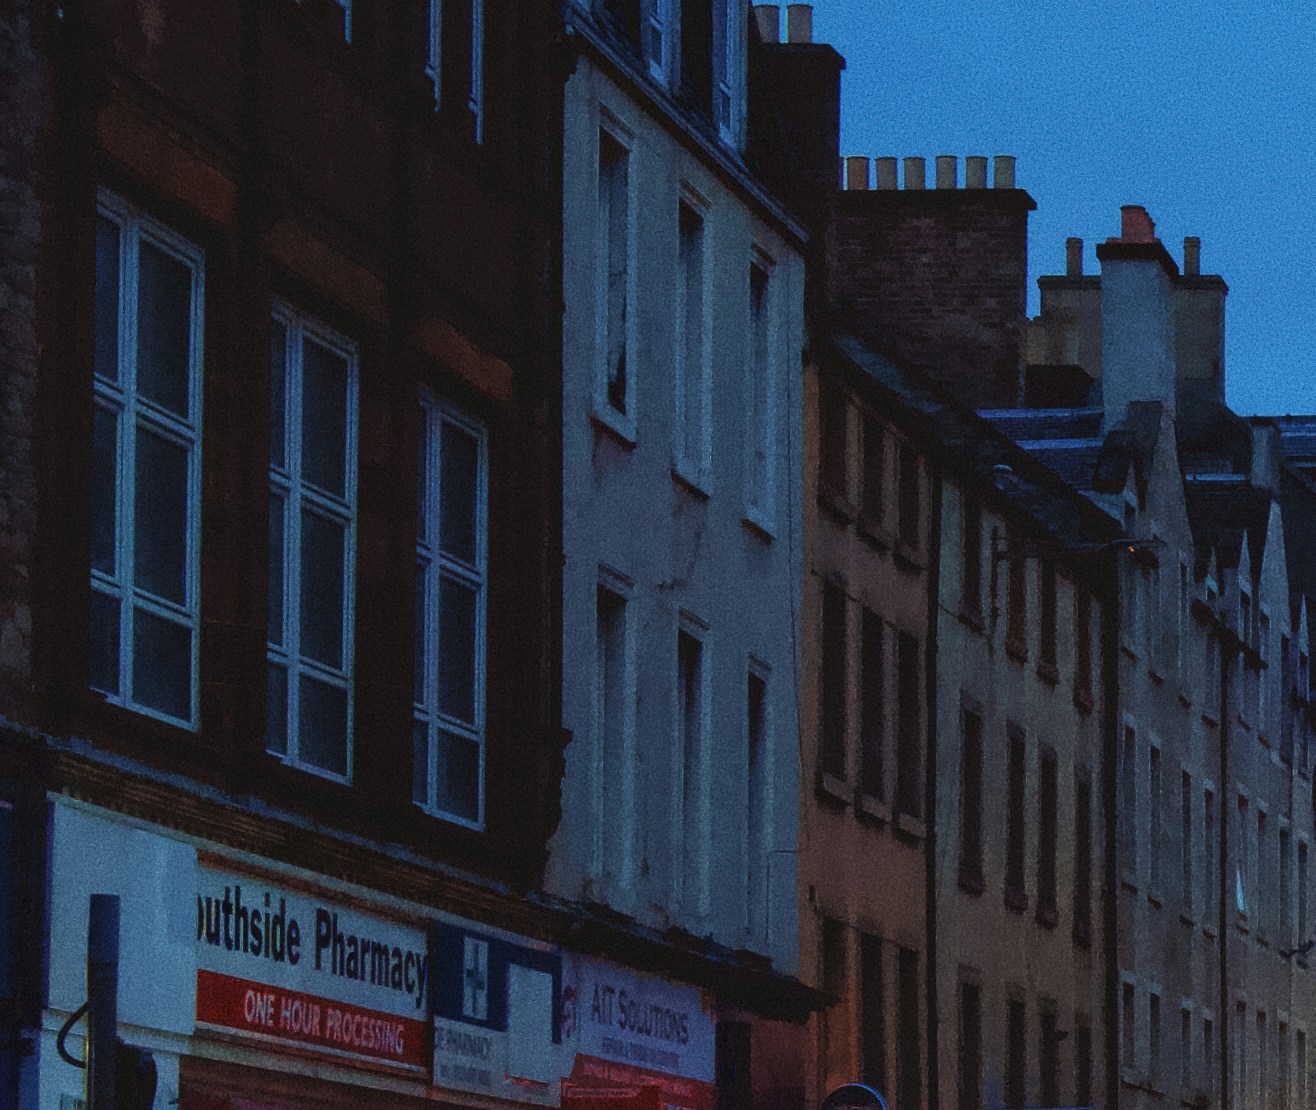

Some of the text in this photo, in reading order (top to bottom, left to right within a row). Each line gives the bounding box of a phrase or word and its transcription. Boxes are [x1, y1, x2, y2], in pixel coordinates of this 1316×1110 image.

[314, 907, 429, 1009] Pharmacy
[244, 989, 405, 1055] ONE HOUR PROCESSING
